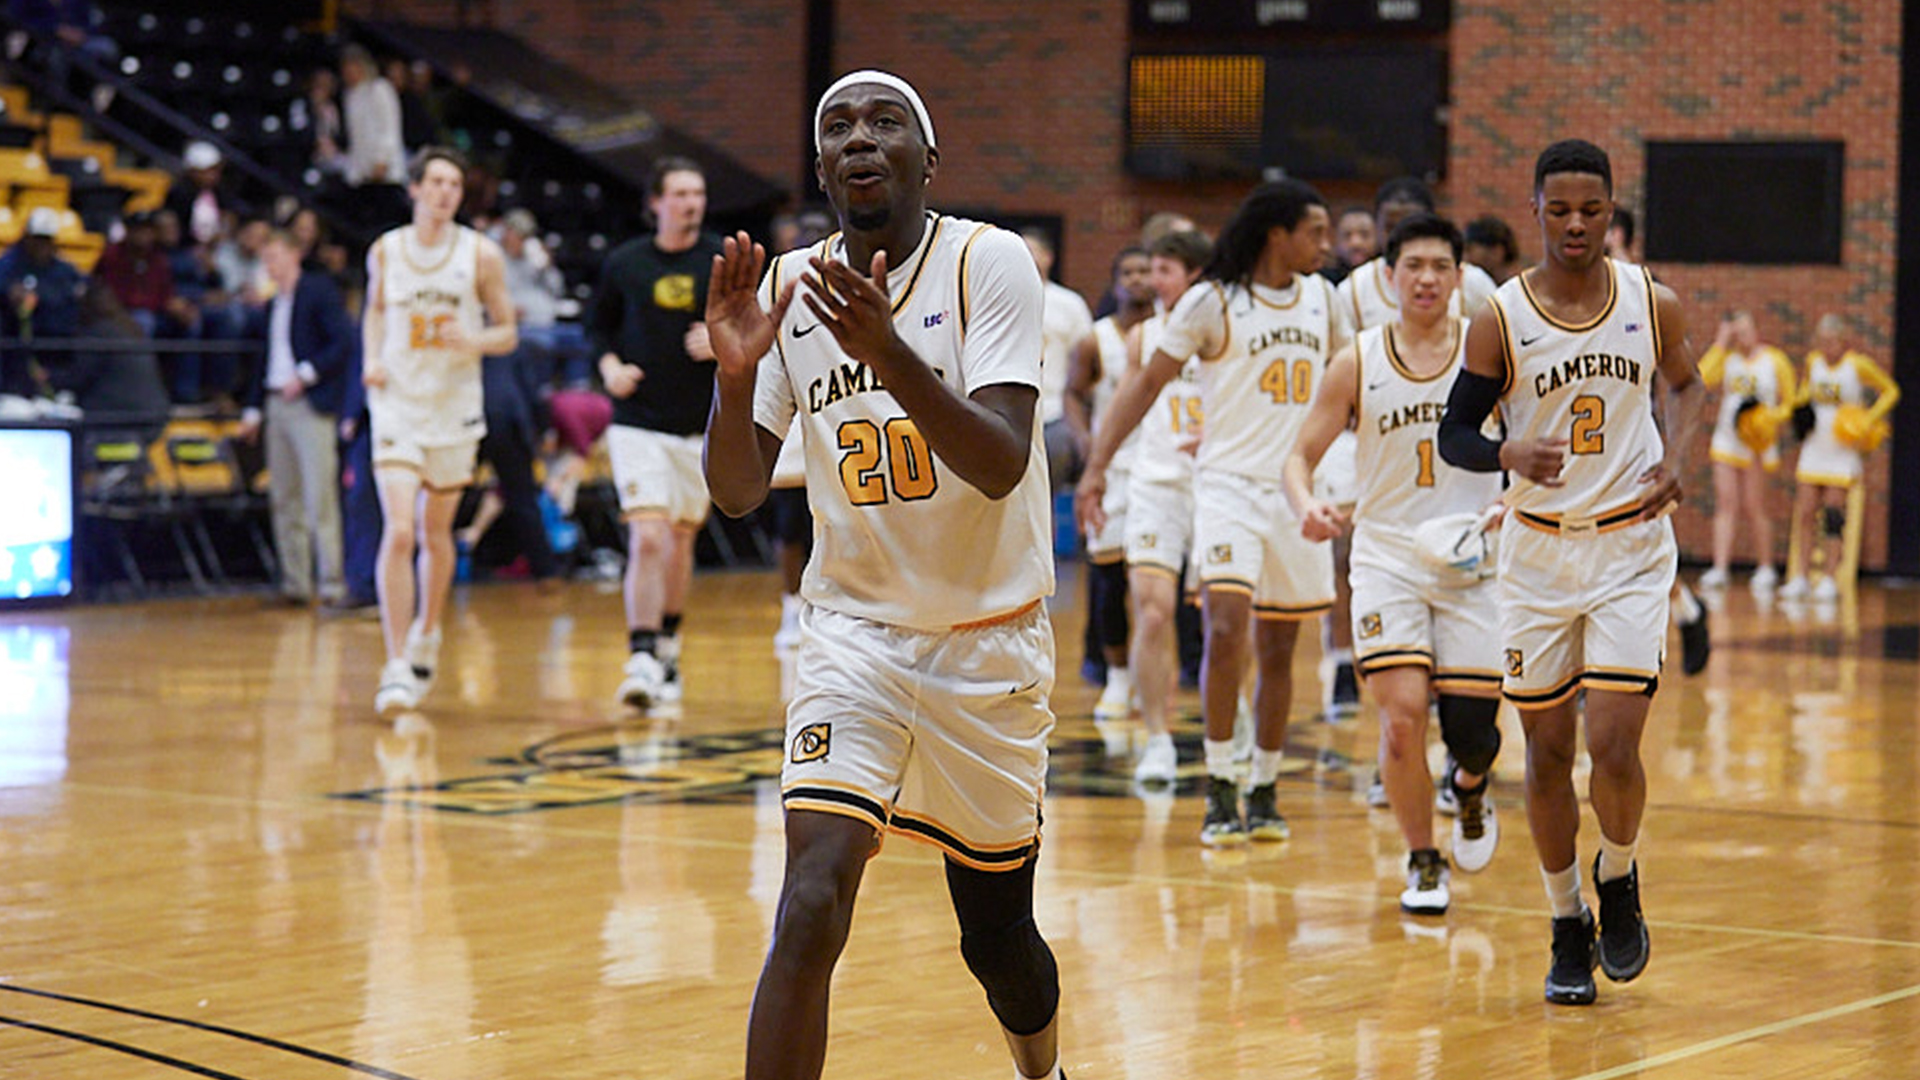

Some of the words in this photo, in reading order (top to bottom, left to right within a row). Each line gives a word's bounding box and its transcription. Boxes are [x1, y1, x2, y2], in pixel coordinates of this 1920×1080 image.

[1259, 357, 1312, 404] 40
[1534, 353, 1641, 398] CAMERON
[1378, 402, 1450, 435] CAMER
[1570, 394, 1605, 455] 2
[837, 415, 938, 506] 20
[1416, 438, 1435, 488] 1
